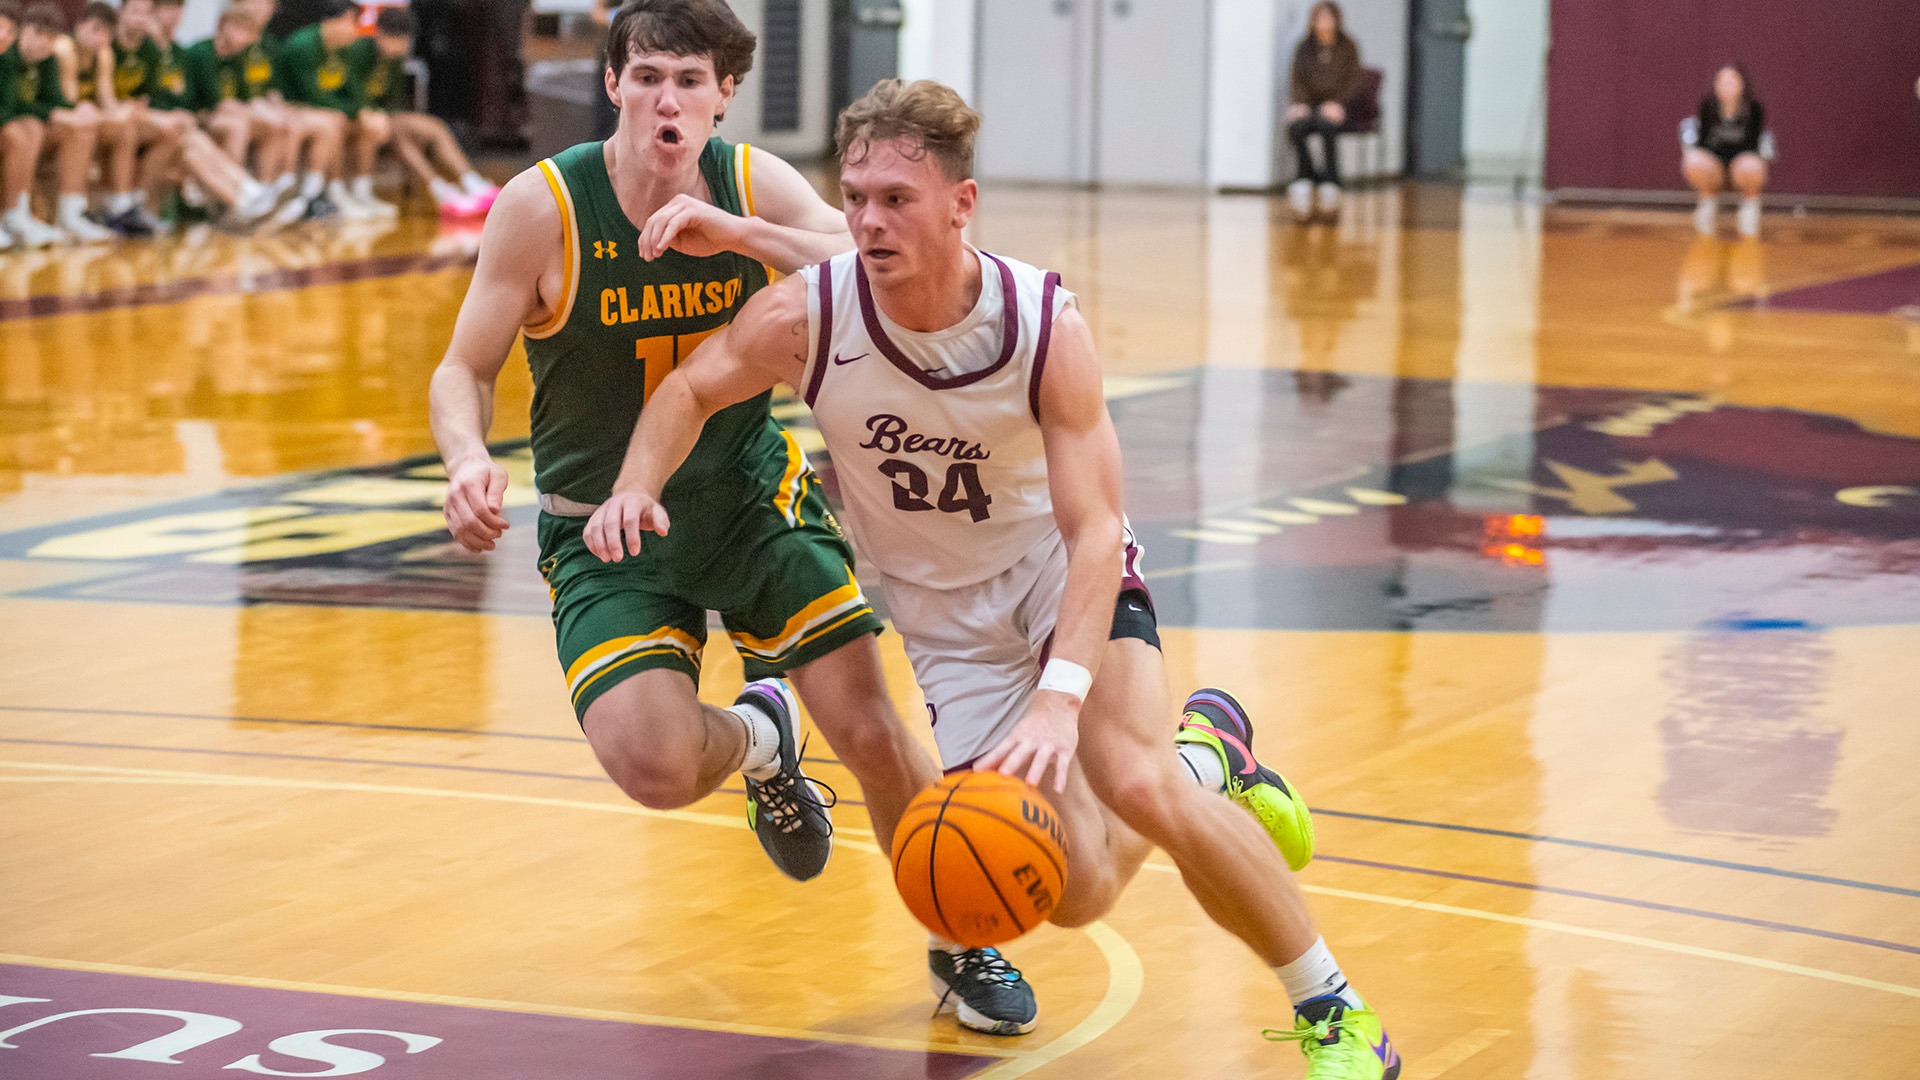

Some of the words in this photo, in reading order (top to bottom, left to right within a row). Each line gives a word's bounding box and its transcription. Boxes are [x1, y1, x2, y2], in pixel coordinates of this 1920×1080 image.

[601, 274, 742, 326] CLARKSO
[635, 321, 729, 409] 1
[859, 413, 991, 460] Bears
[878, 458, 993, 523] 24
[0, 994, 444, 1078] SU
